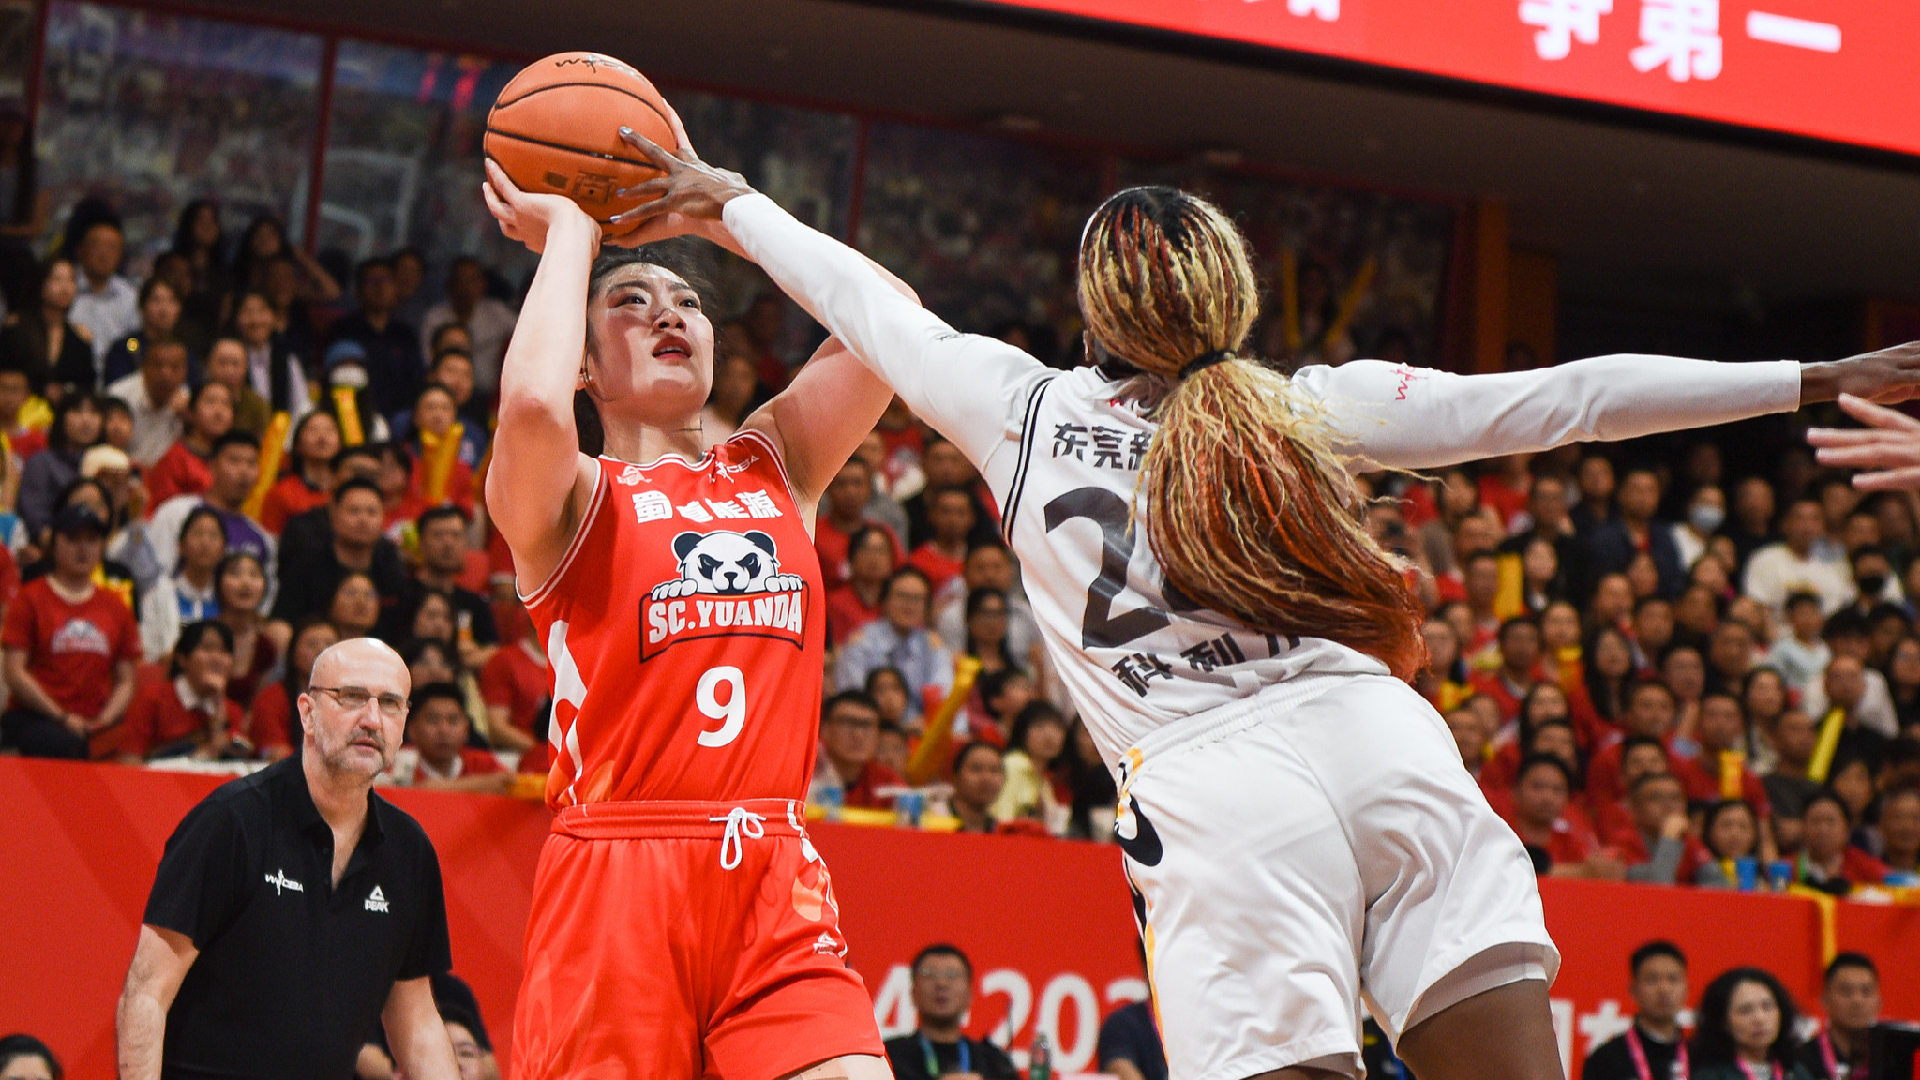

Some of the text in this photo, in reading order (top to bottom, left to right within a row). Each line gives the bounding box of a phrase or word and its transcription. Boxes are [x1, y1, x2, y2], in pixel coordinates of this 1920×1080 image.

[648, 591, 803, 644] SC.YUANDA
[696, 665, 746, 748] 9
[364, 898, 390, 914] PEAK
